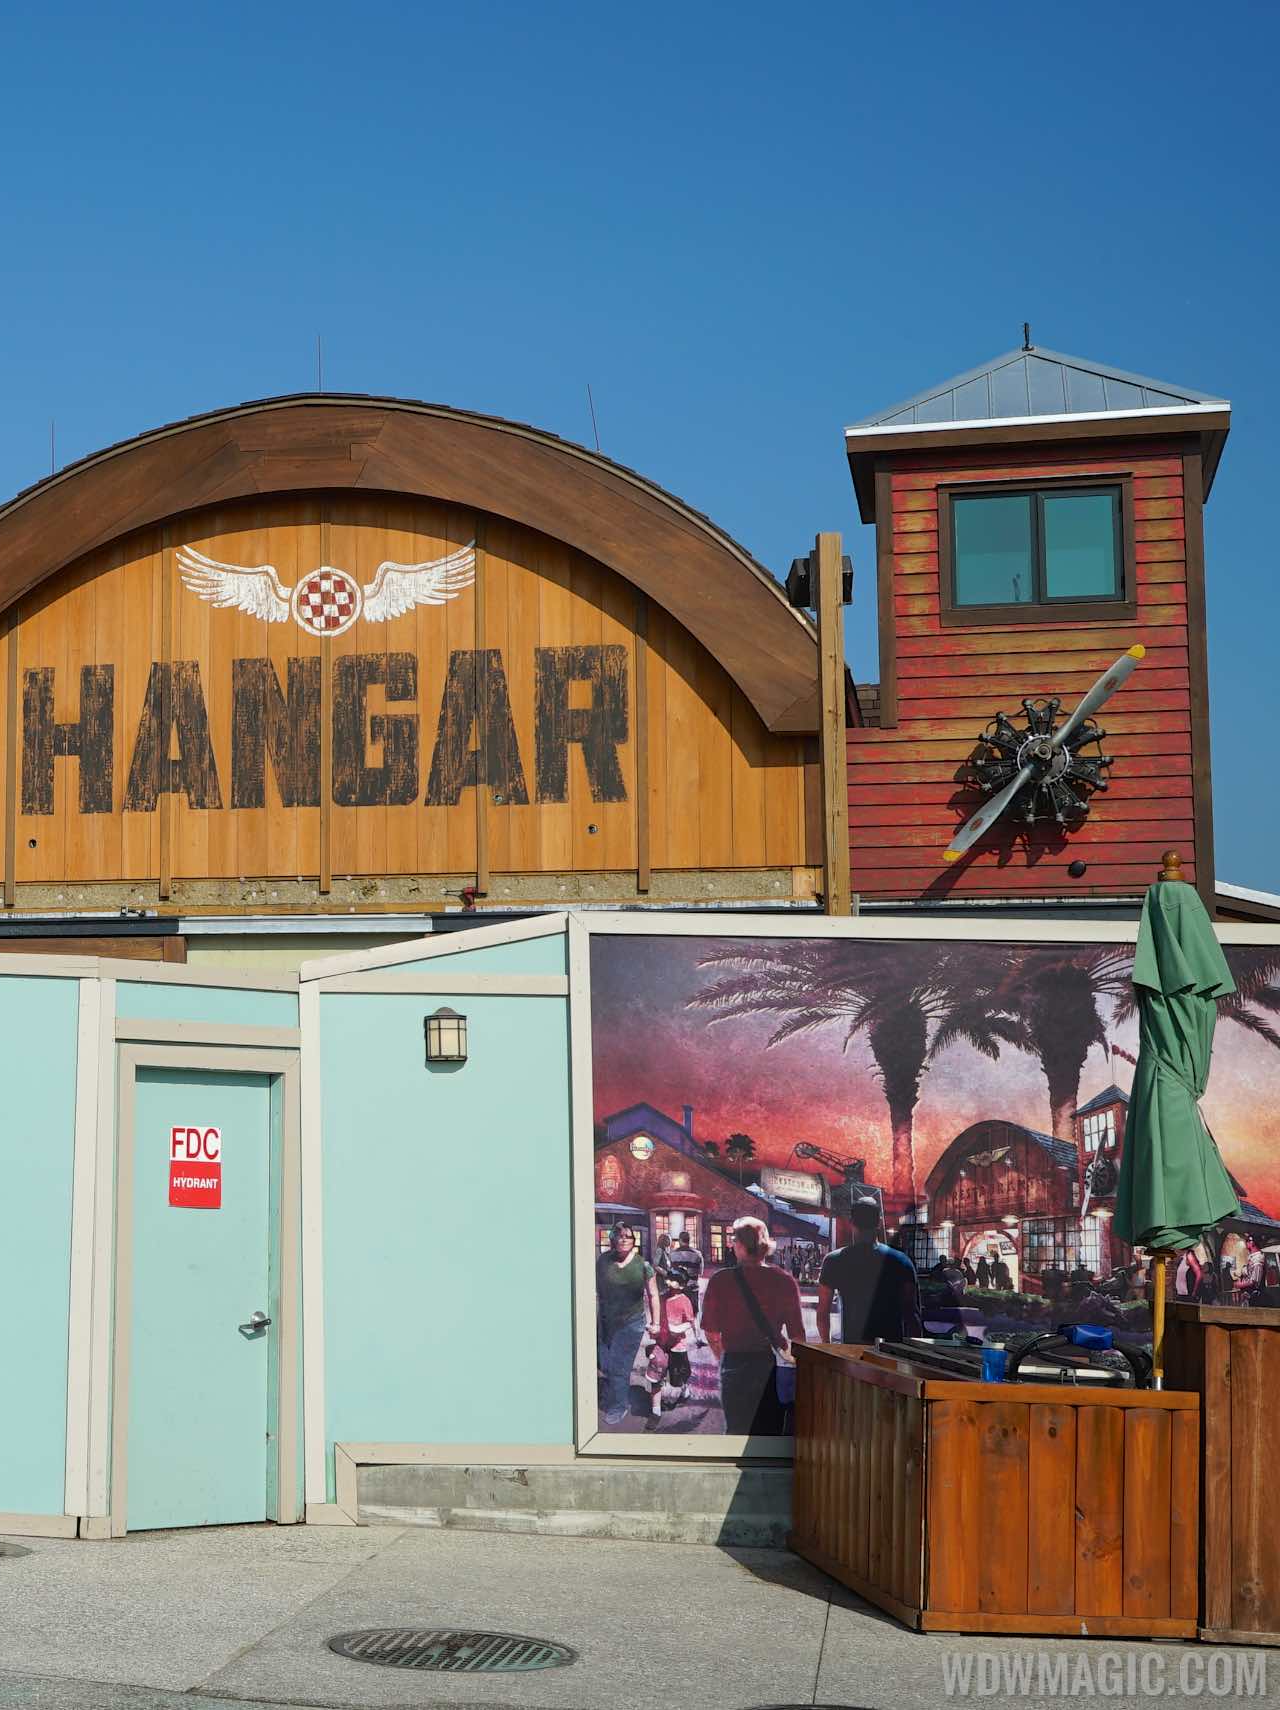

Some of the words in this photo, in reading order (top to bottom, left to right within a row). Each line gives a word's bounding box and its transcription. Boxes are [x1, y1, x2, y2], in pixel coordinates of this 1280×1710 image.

[22, 644, 629, 815] HANGAR
[172, 1127, 219, 1160] FDC
[173, 1176, 219, 1189] HYDRANT
